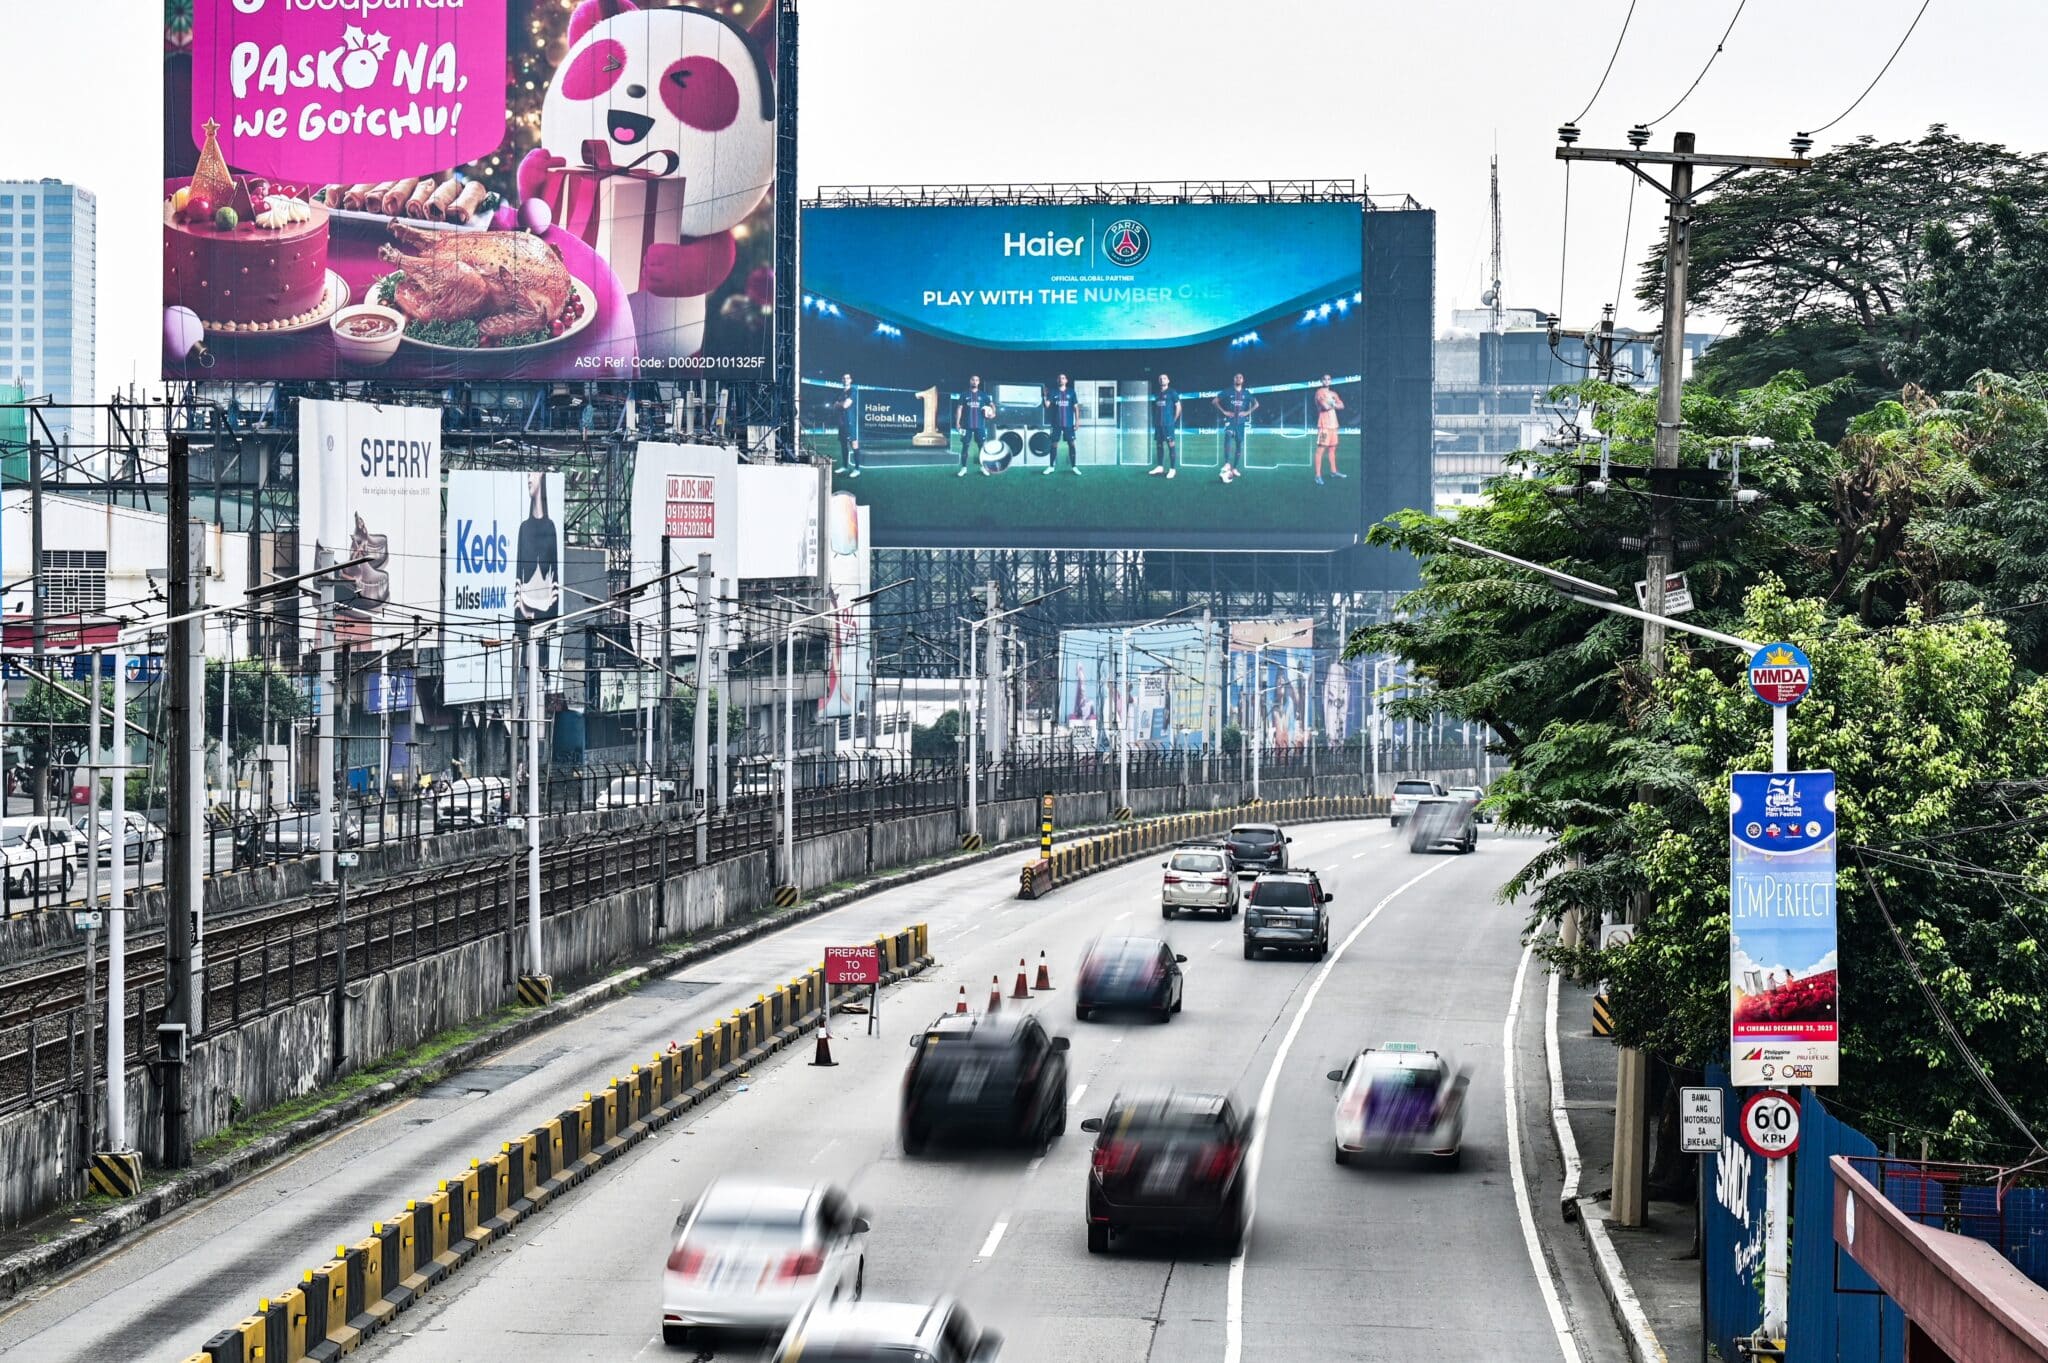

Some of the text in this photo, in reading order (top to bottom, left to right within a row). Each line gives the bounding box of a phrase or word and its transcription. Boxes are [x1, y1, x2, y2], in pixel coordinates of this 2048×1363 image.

[392, 41, 468, 95] NA,
[1110, 221, 1142, 233] PARIS
[1004, 231, 1085, 257] Haier
[923, 290, 974, 306] PLAY
[980, 289, 1033, 305] WITH
[1039, 288, 1078, 305] THE
[1084, 287, 1172, 304] NUMBER
[574, 356, 766, 368] ASC Ref. Code: D0002D101325F
[864, 403, 890, 412] Haier
[864, 413, 917, 422] Global No.1
[360, 437, 432, 478] SPERRY
[668, 479, 679, 498] UR
[681, 479, 696, 499] ADS
[456, 519, 507, 574] Keds
[1753, 669, 1806, 683] MMDA
[828, 948, 876, 958] PREPARE
[845, 960, 860, 970] TO
[839, 972, 867, 982] STOP
[1691, 1093, 1711, 1102] BAWAL
[1695, 1104, 1708, 1113] ANG
[1684, 1116, 1720, 1125] MOTORSIKLO
[1754, 1105, 1791, 1130] 60
[1698, 1127, 1706, 1135] SA
[1687, 1138, 1717, 1146] BIKE LANE
[1762, 1134, 1786, 1143] KPH
